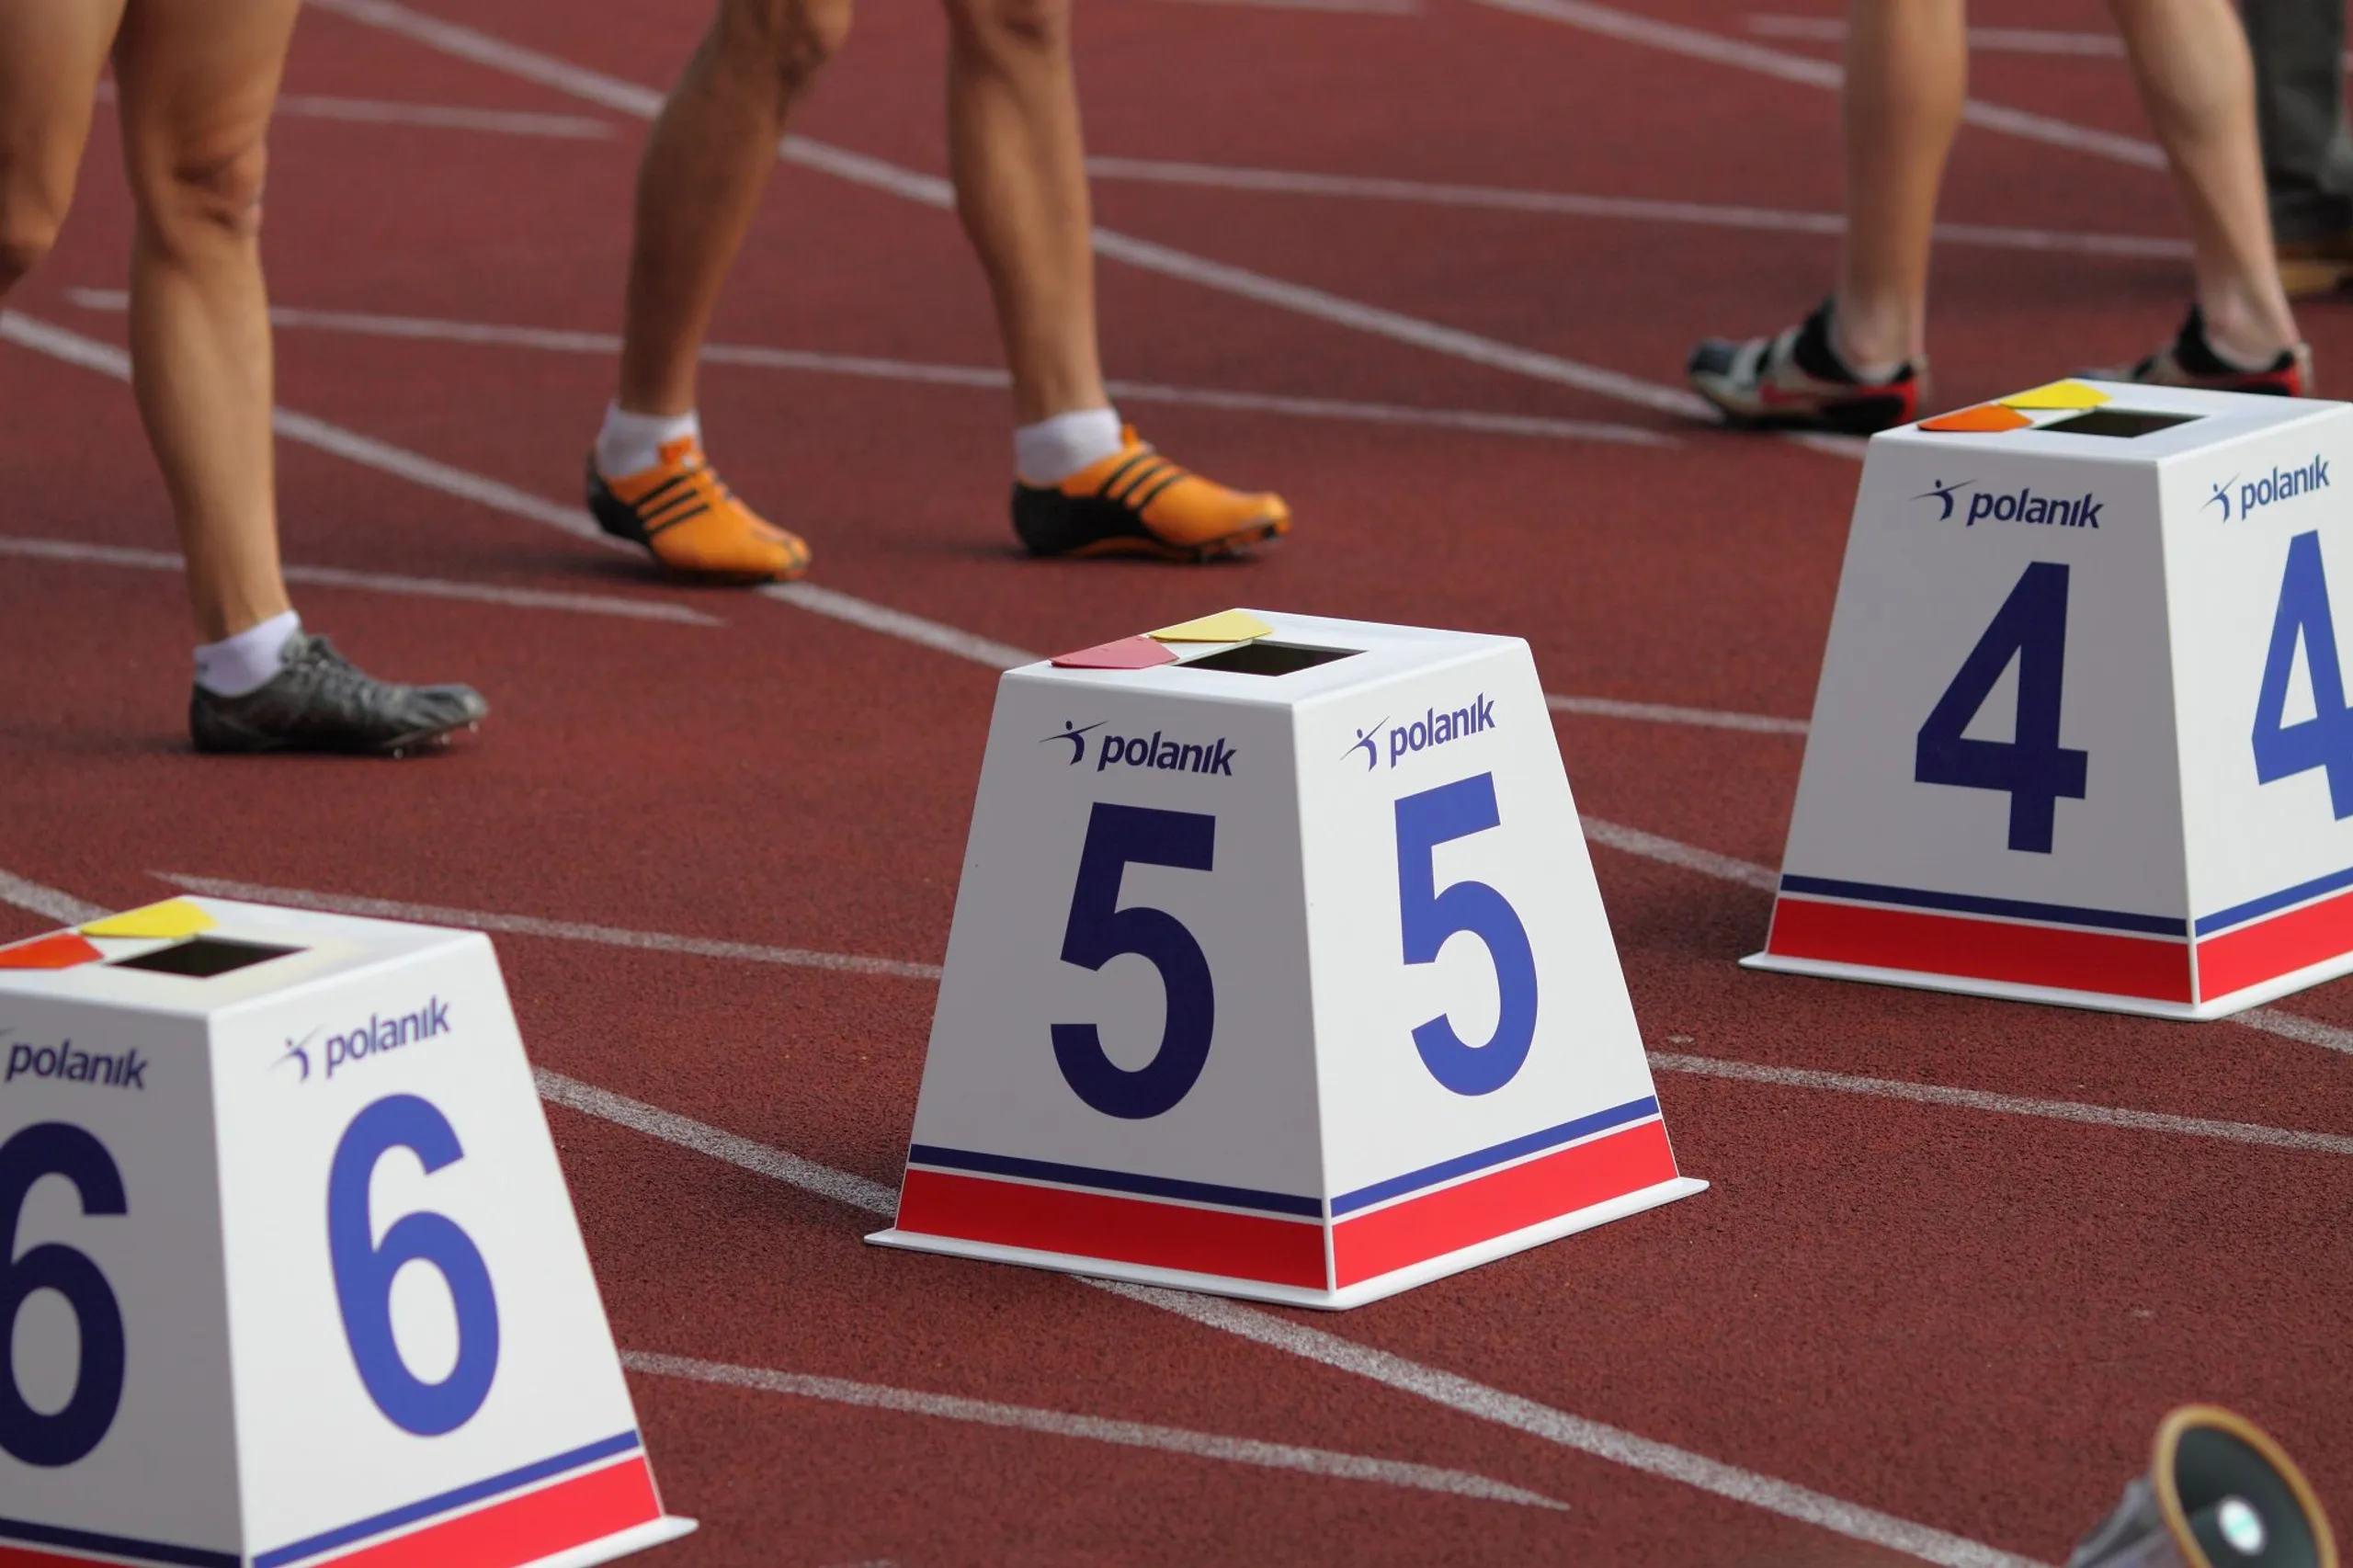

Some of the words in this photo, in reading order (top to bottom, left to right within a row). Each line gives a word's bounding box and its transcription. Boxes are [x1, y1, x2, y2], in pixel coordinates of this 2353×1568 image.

[1915, 562, 2088, 854] 4
[2251, 529, 2353, 822] 4
[1051, 802, 1215, 1119] 5
[1393, 771, 1539, 1096] 5
[0, 1121, 128, 1468] 6
[327, 1093, 500, 1437] 6
